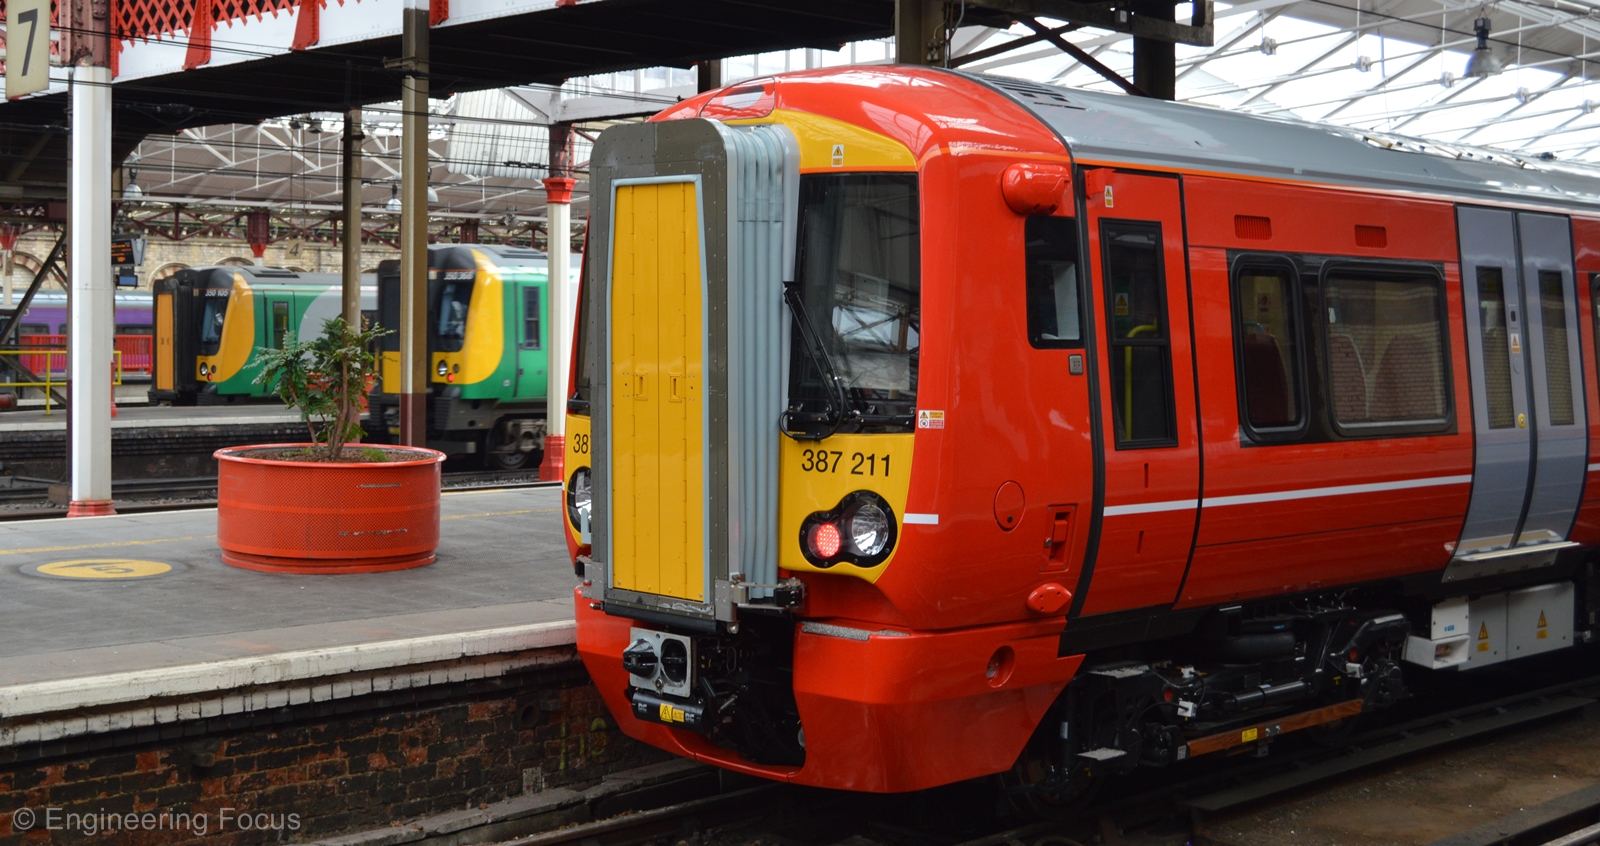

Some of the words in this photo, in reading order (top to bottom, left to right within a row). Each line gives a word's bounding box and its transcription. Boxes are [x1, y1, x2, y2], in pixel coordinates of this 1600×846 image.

[17, 8, 38, 77] 7
[289, 243, 300, 256] 4
[573, 433, 590, 454] 38
[801, 449, 843, 473] 387
[850, 452, 890, 477] 211
